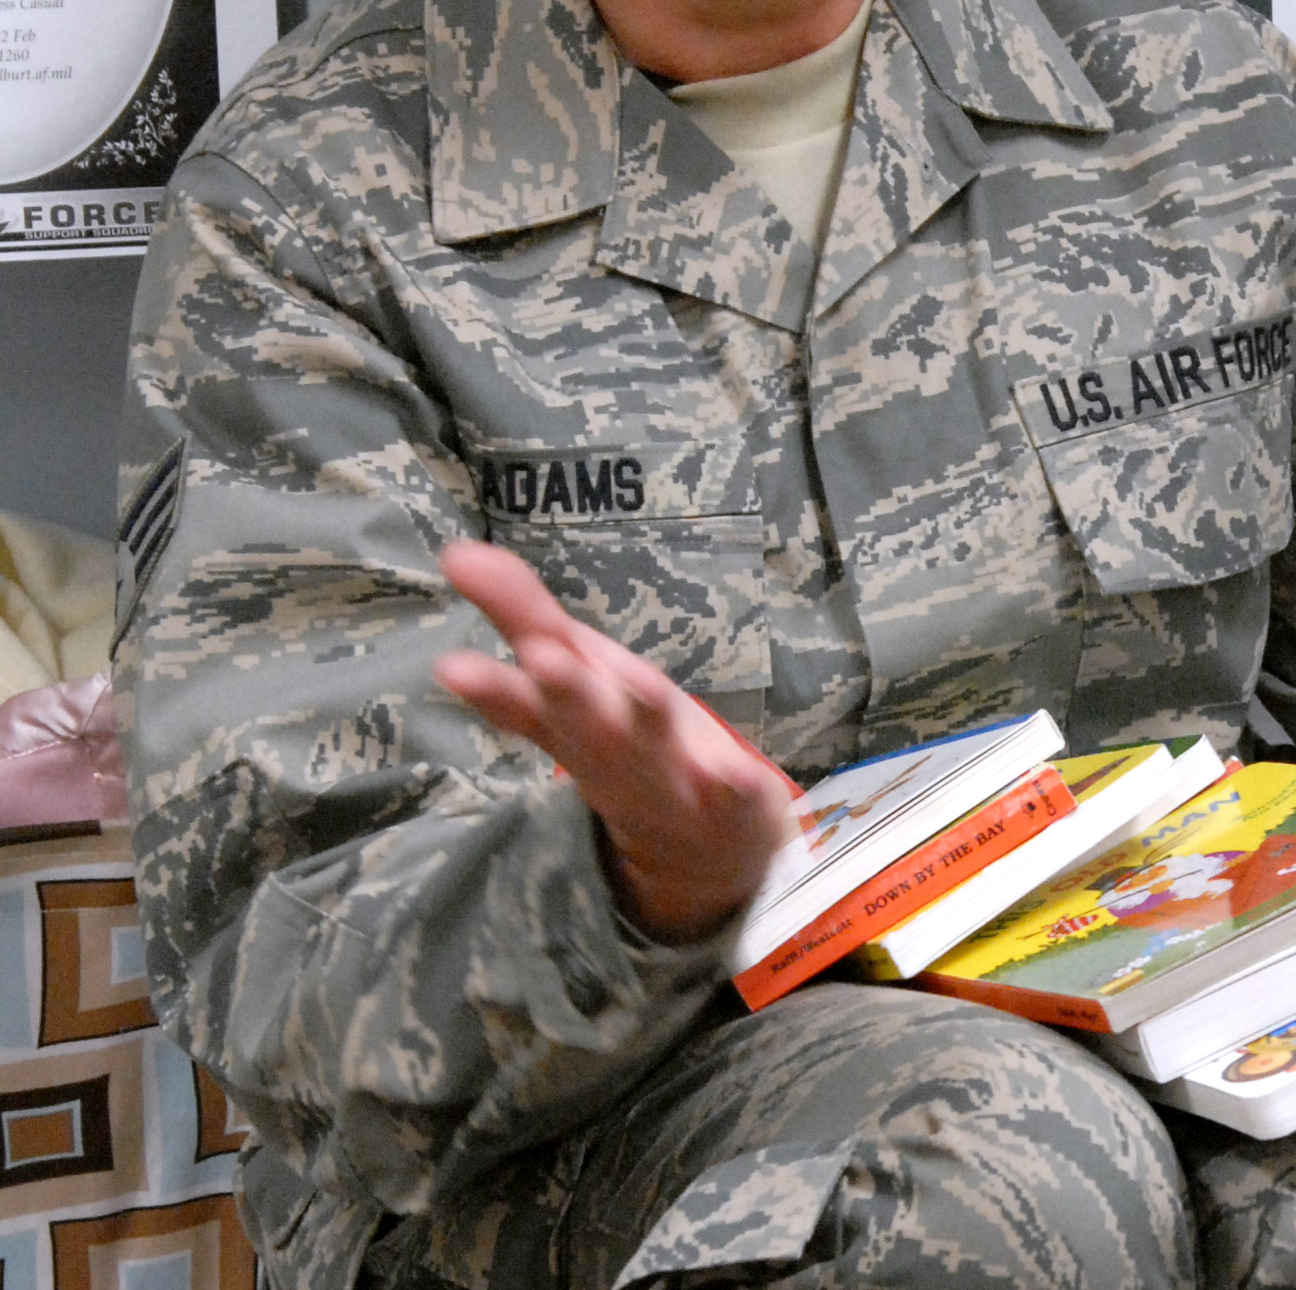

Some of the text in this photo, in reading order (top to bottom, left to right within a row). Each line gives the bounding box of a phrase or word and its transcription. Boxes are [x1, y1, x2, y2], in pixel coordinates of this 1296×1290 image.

[14, 28, 36, 43] Feb
[25, 227, 87, 240] SUPPORT
[1039, 316, 1294, 432] U.S. AIR FORCE
[482, 456, 645, 515] ADAMS
[1141, 790, 1242, 848] MAN
[862, 879, 913, 917] DOWN
[913, 862, 938, 885] BY
[937, 838, 974, 870] THE
[974, 819, 1008, 847] BAY
